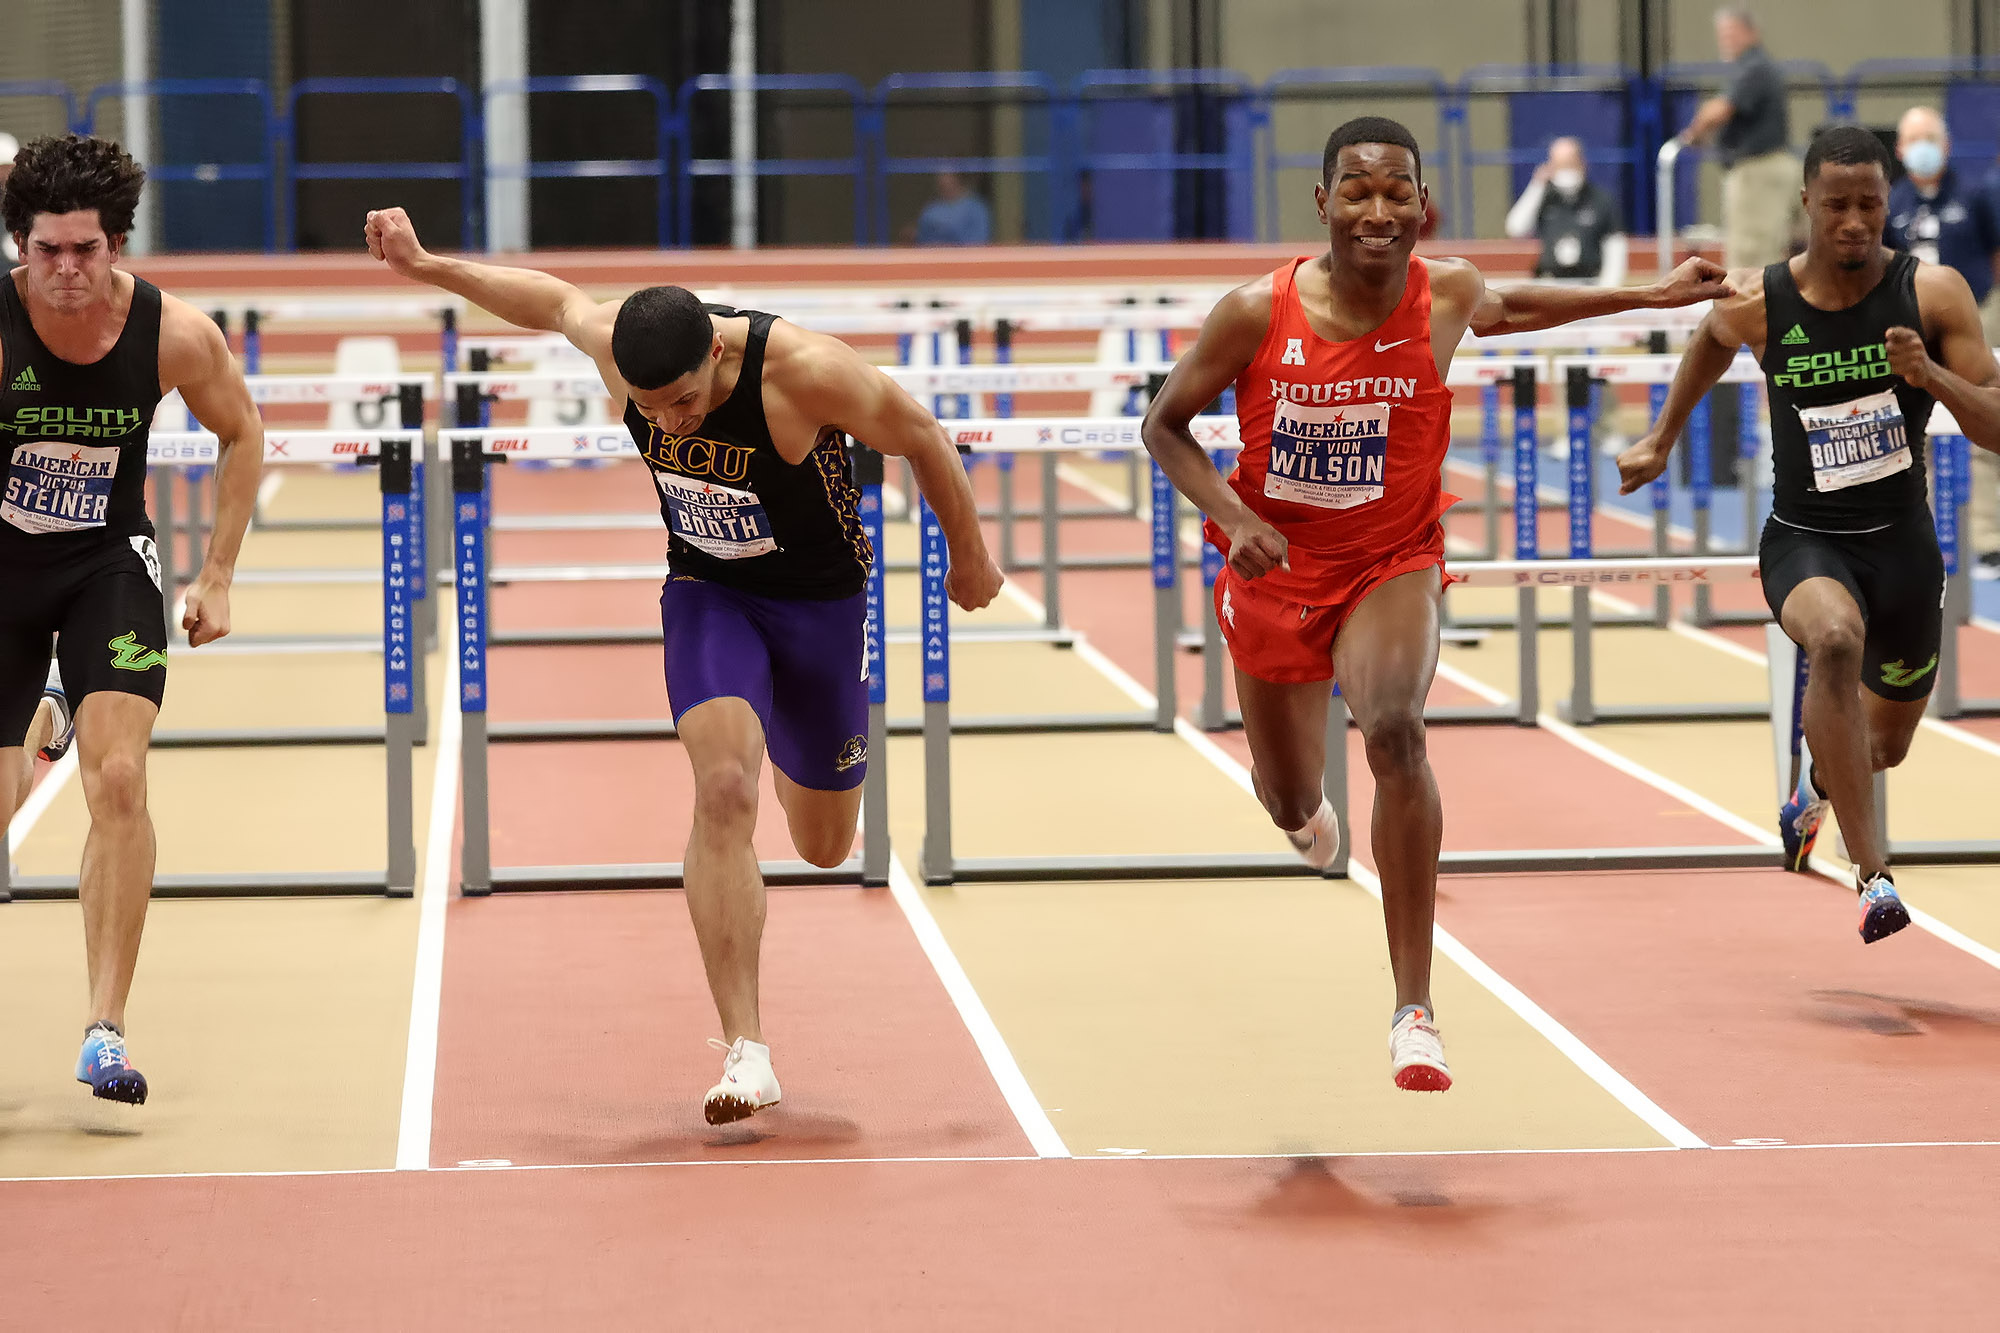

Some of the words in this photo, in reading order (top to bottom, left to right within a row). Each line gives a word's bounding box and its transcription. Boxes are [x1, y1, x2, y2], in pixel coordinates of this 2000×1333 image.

[1281, 338, 1306, 366] A
[11, 381, 41, 392] adidas
[1773, 361, 1892, 388] FLORID
[1269, 376, 1417, 403] HOUSTON
[13, 406, 139, 425] SOUTH
[1277, 416, 1381, 439] AMERICAN
[956, 431, 993, 443] GILL
[1829, 420, 1884, 441] MICHAEL
[332, 442, 369, 455] GILL
[491, 439, 528, 452] GILL
[643, 422, 756, 482] ECU
[1327, 441, 1361, 455] VION
[1811, 433, 1885, 468] BOURNE
[15, 450, 112, 477] AMERICAN
[1271, 446, 1384, 482] WILSON
[39, 473, 86, 492] VICTOR
[663, 482, 752, 506] AMERICAN
[5, 476, 109, 520] STEINER
[682, 502, 740, 520] TERENCE
[677, 509, 760, 540] BOOTH
[389, 533, 406, 671] BIRMINGHAM
[462, 533, 480, 671] BIRMINGHAM
[926, 525, 944, 661] BIRMINGHAM
